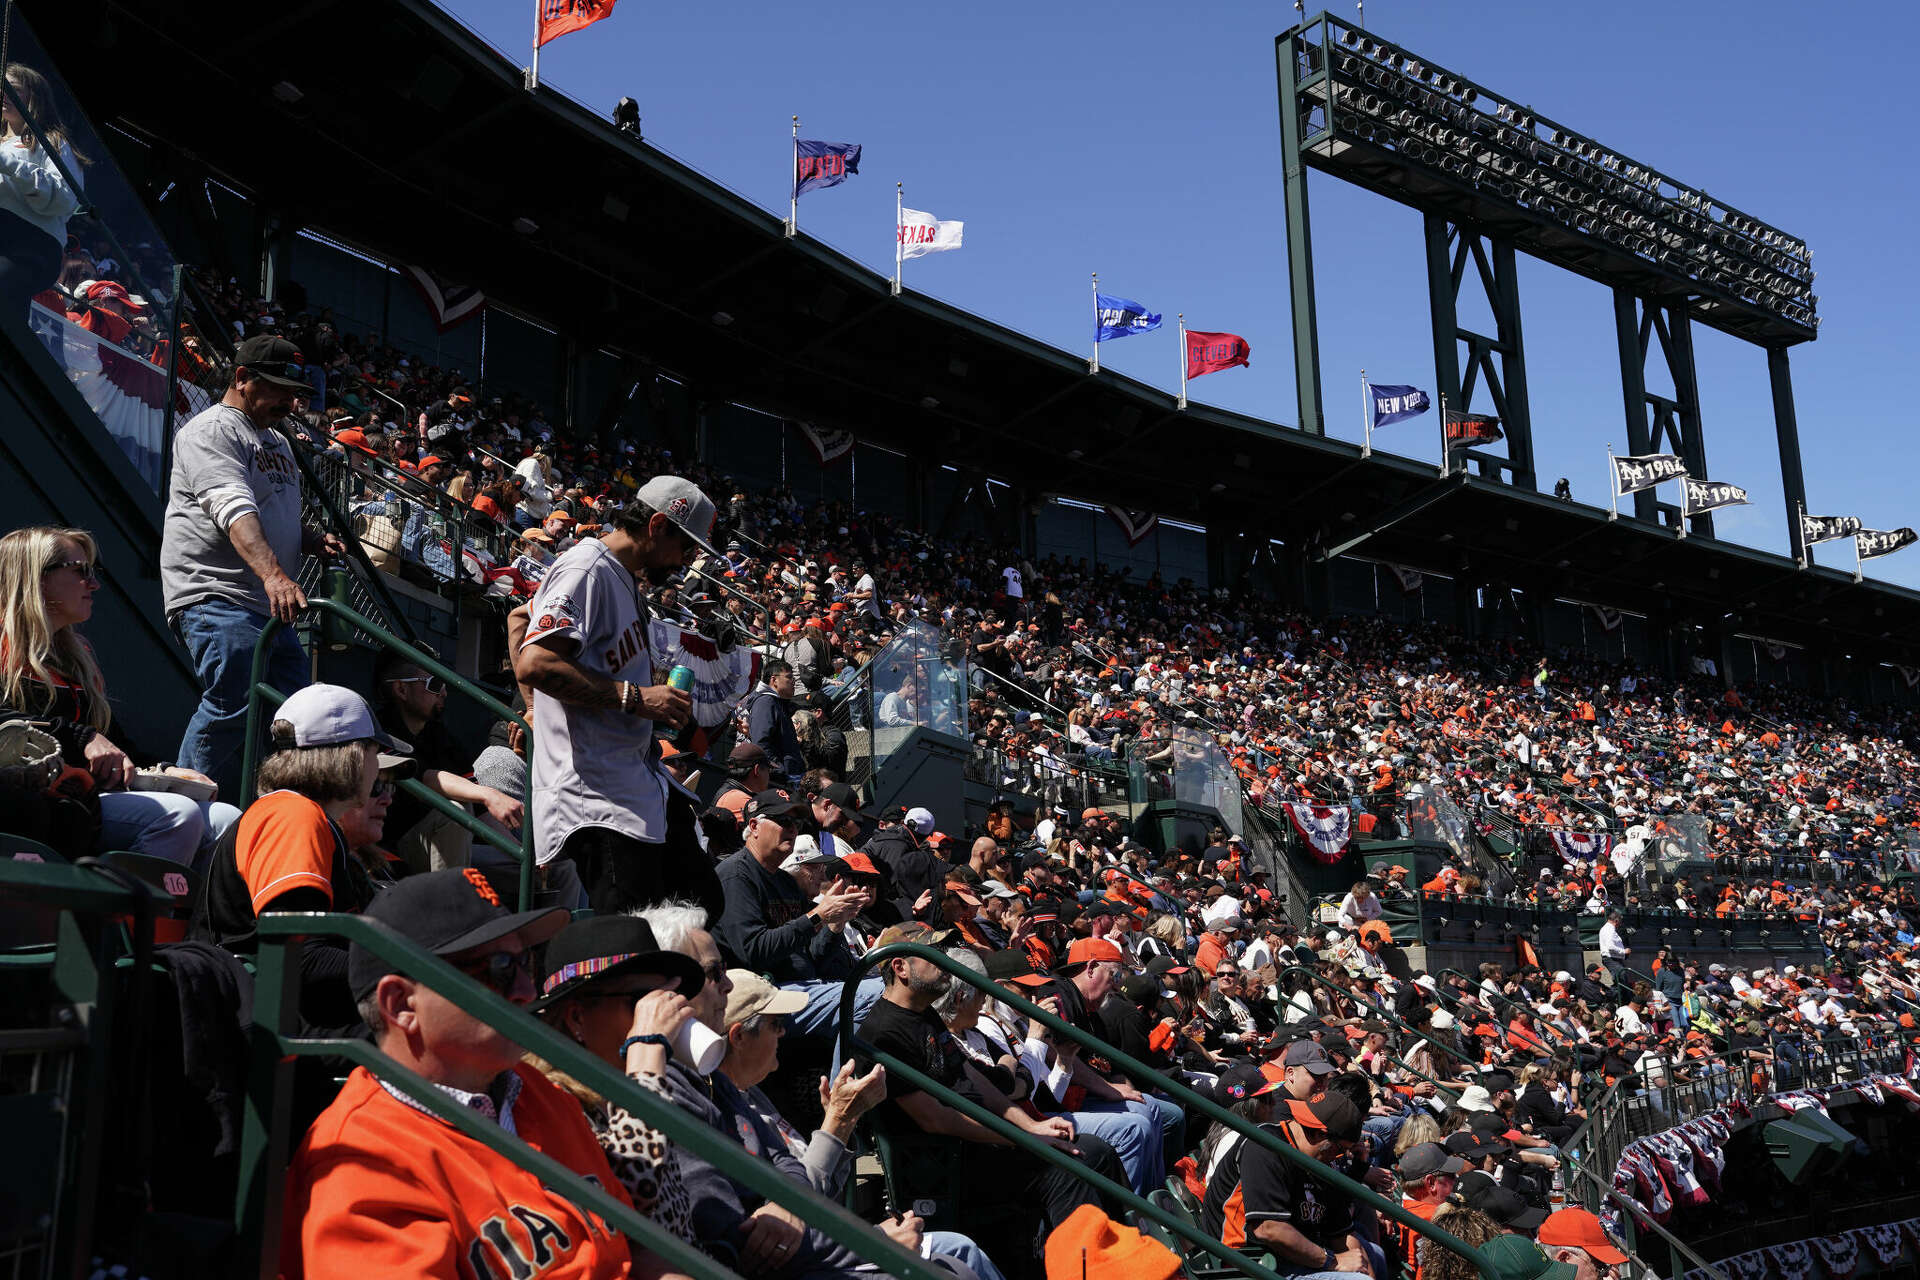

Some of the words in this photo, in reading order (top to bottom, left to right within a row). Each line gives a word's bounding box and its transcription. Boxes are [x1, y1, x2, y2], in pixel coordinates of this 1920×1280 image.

[1377, 397, 1400, 414] NEW
[605, 627, 637, 674] SAN
[168, 876, 185, 893] 16
